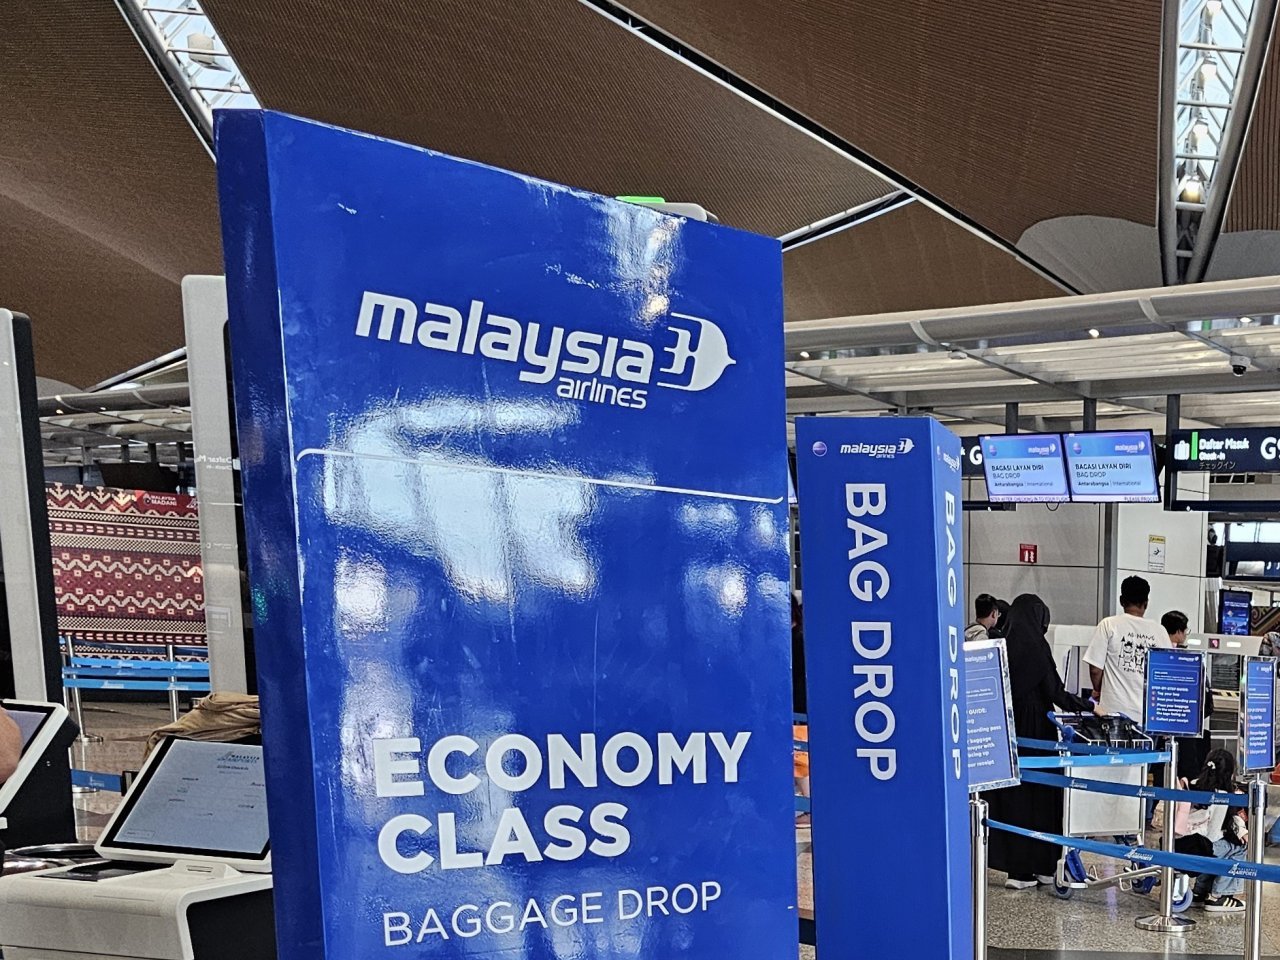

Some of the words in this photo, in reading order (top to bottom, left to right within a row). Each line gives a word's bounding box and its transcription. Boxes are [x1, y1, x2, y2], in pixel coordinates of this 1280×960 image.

[354, 291, 655, 385] malaysia
[556, 377, 648, 410] airlines
[840, 442, 897, 458] malaysia
[1076, 471, 1089, 479] BAG
[845, 483, 890, 602] BAG
[944, 491, 957, 608] BAG
[851, 621, 898, 781] DROP
[948, 625, 961, 780] DROP
[372, 731, 752, 799] ECONOMY
[377, 803, 631, 874] CLASS
[383, 891, 604, 947] BAGGAGE
[617, 881, 722, 919] DROP
